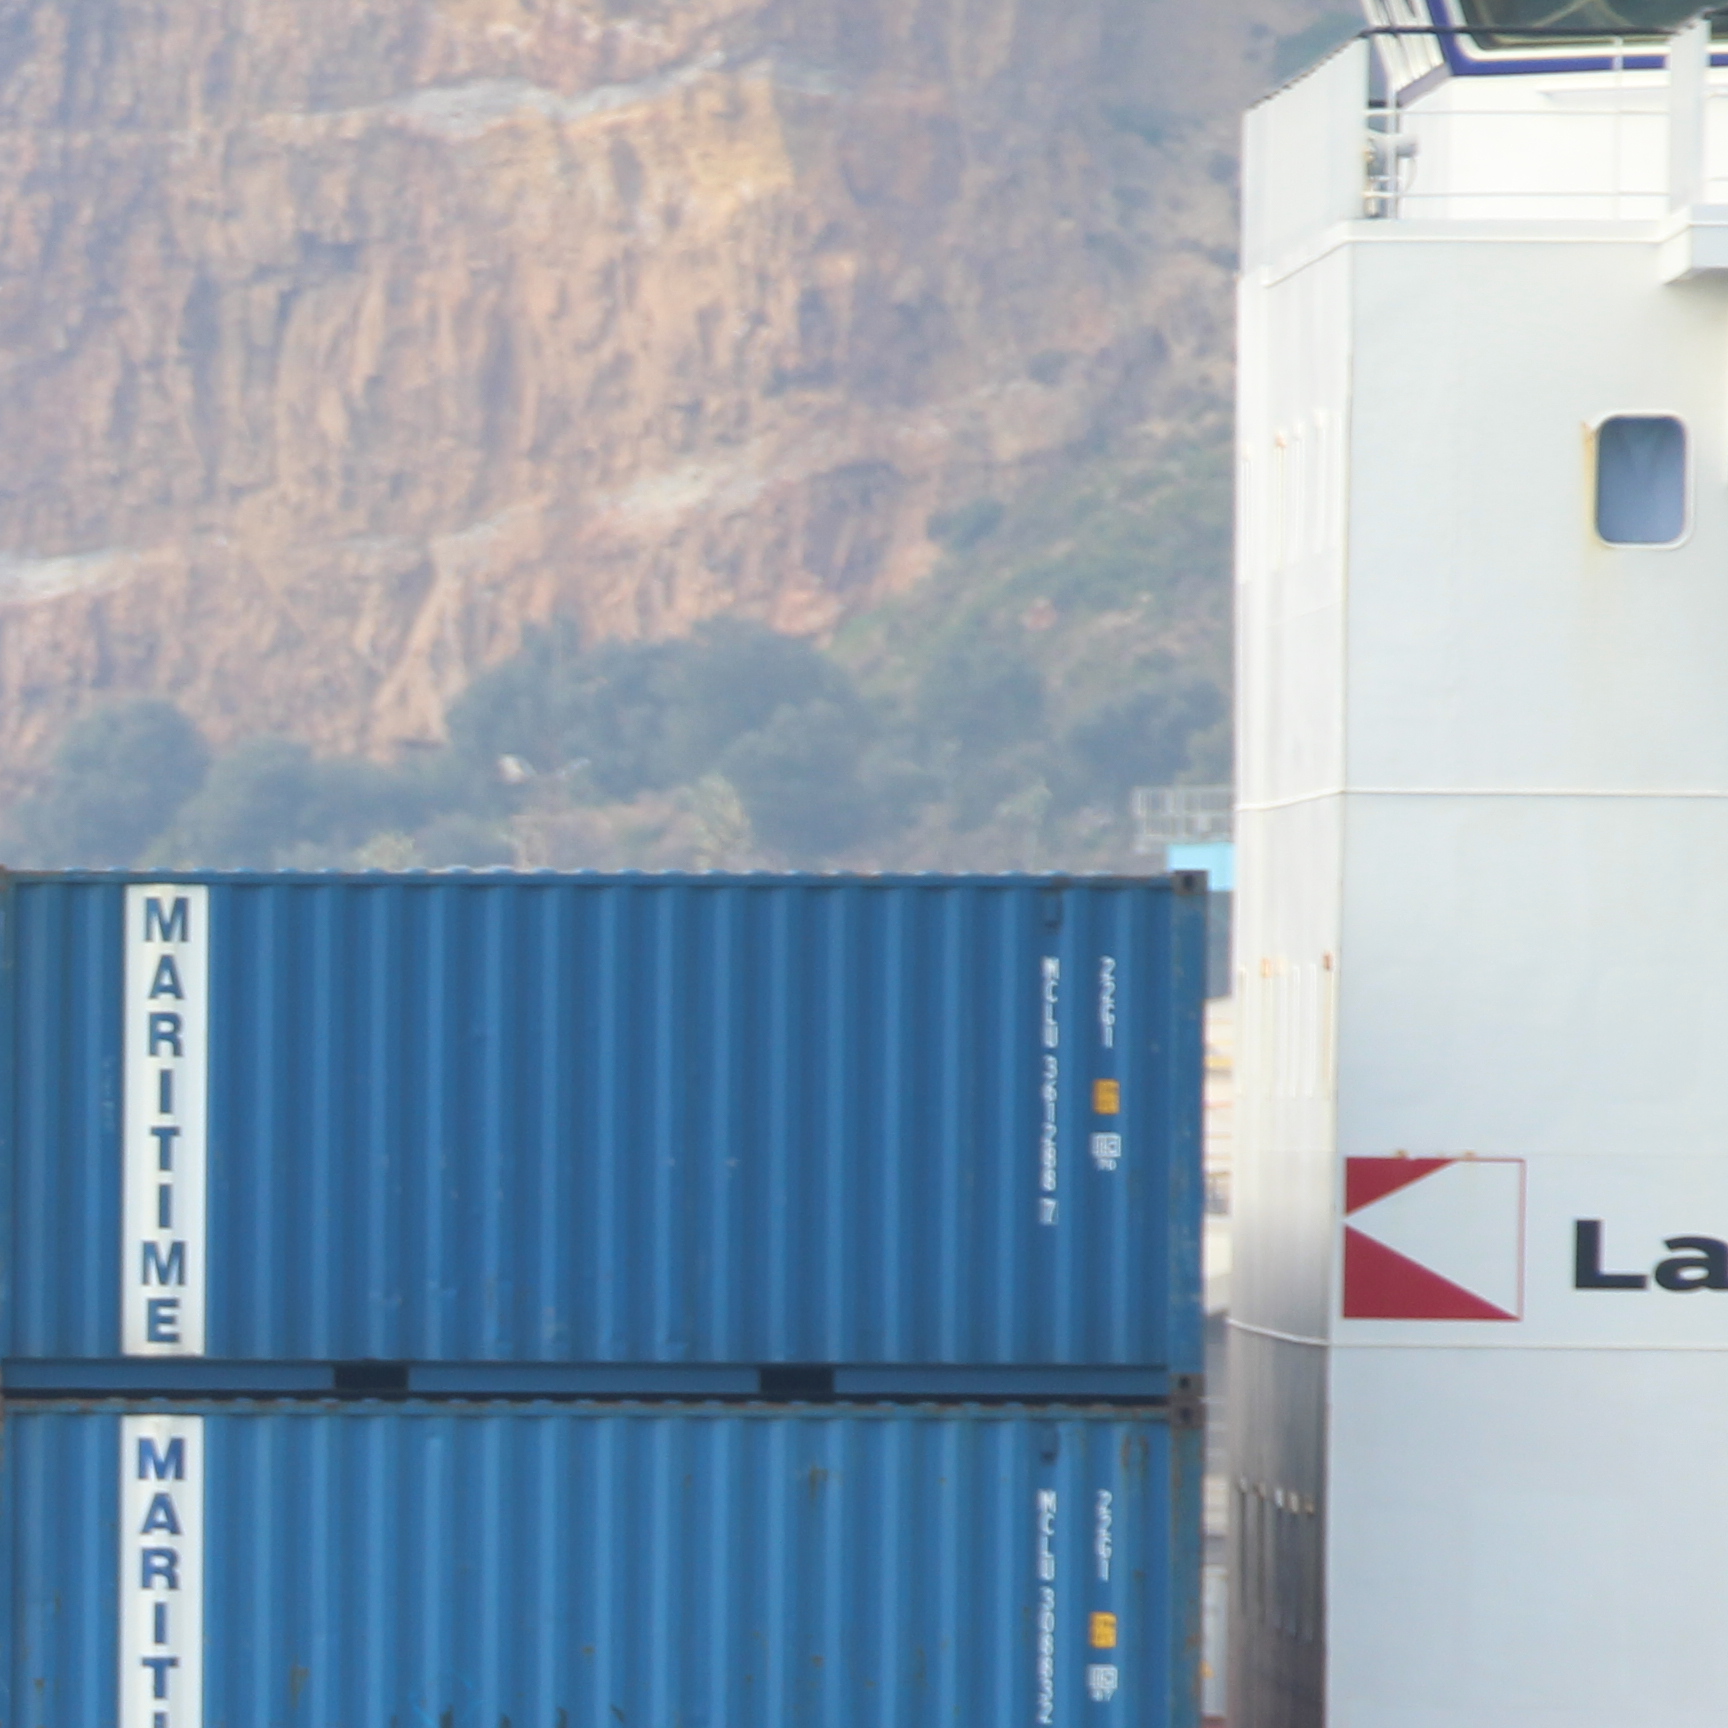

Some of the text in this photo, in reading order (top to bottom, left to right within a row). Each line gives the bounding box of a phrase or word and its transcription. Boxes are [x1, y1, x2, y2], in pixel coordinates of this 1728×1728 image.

[1043, 958, 1060, 1049] MCLU
[1101, 958, 1116, 1048] 22G1
[141, 896, 190, 1346] MARITIME
[1042, 1199, 1057, 1225] 7
[1573, 1219, 1728, 1294] La
[1039, 1491, 1057, 1581] MCLU
[1097, 1491, 1113, 1581] 22G1
